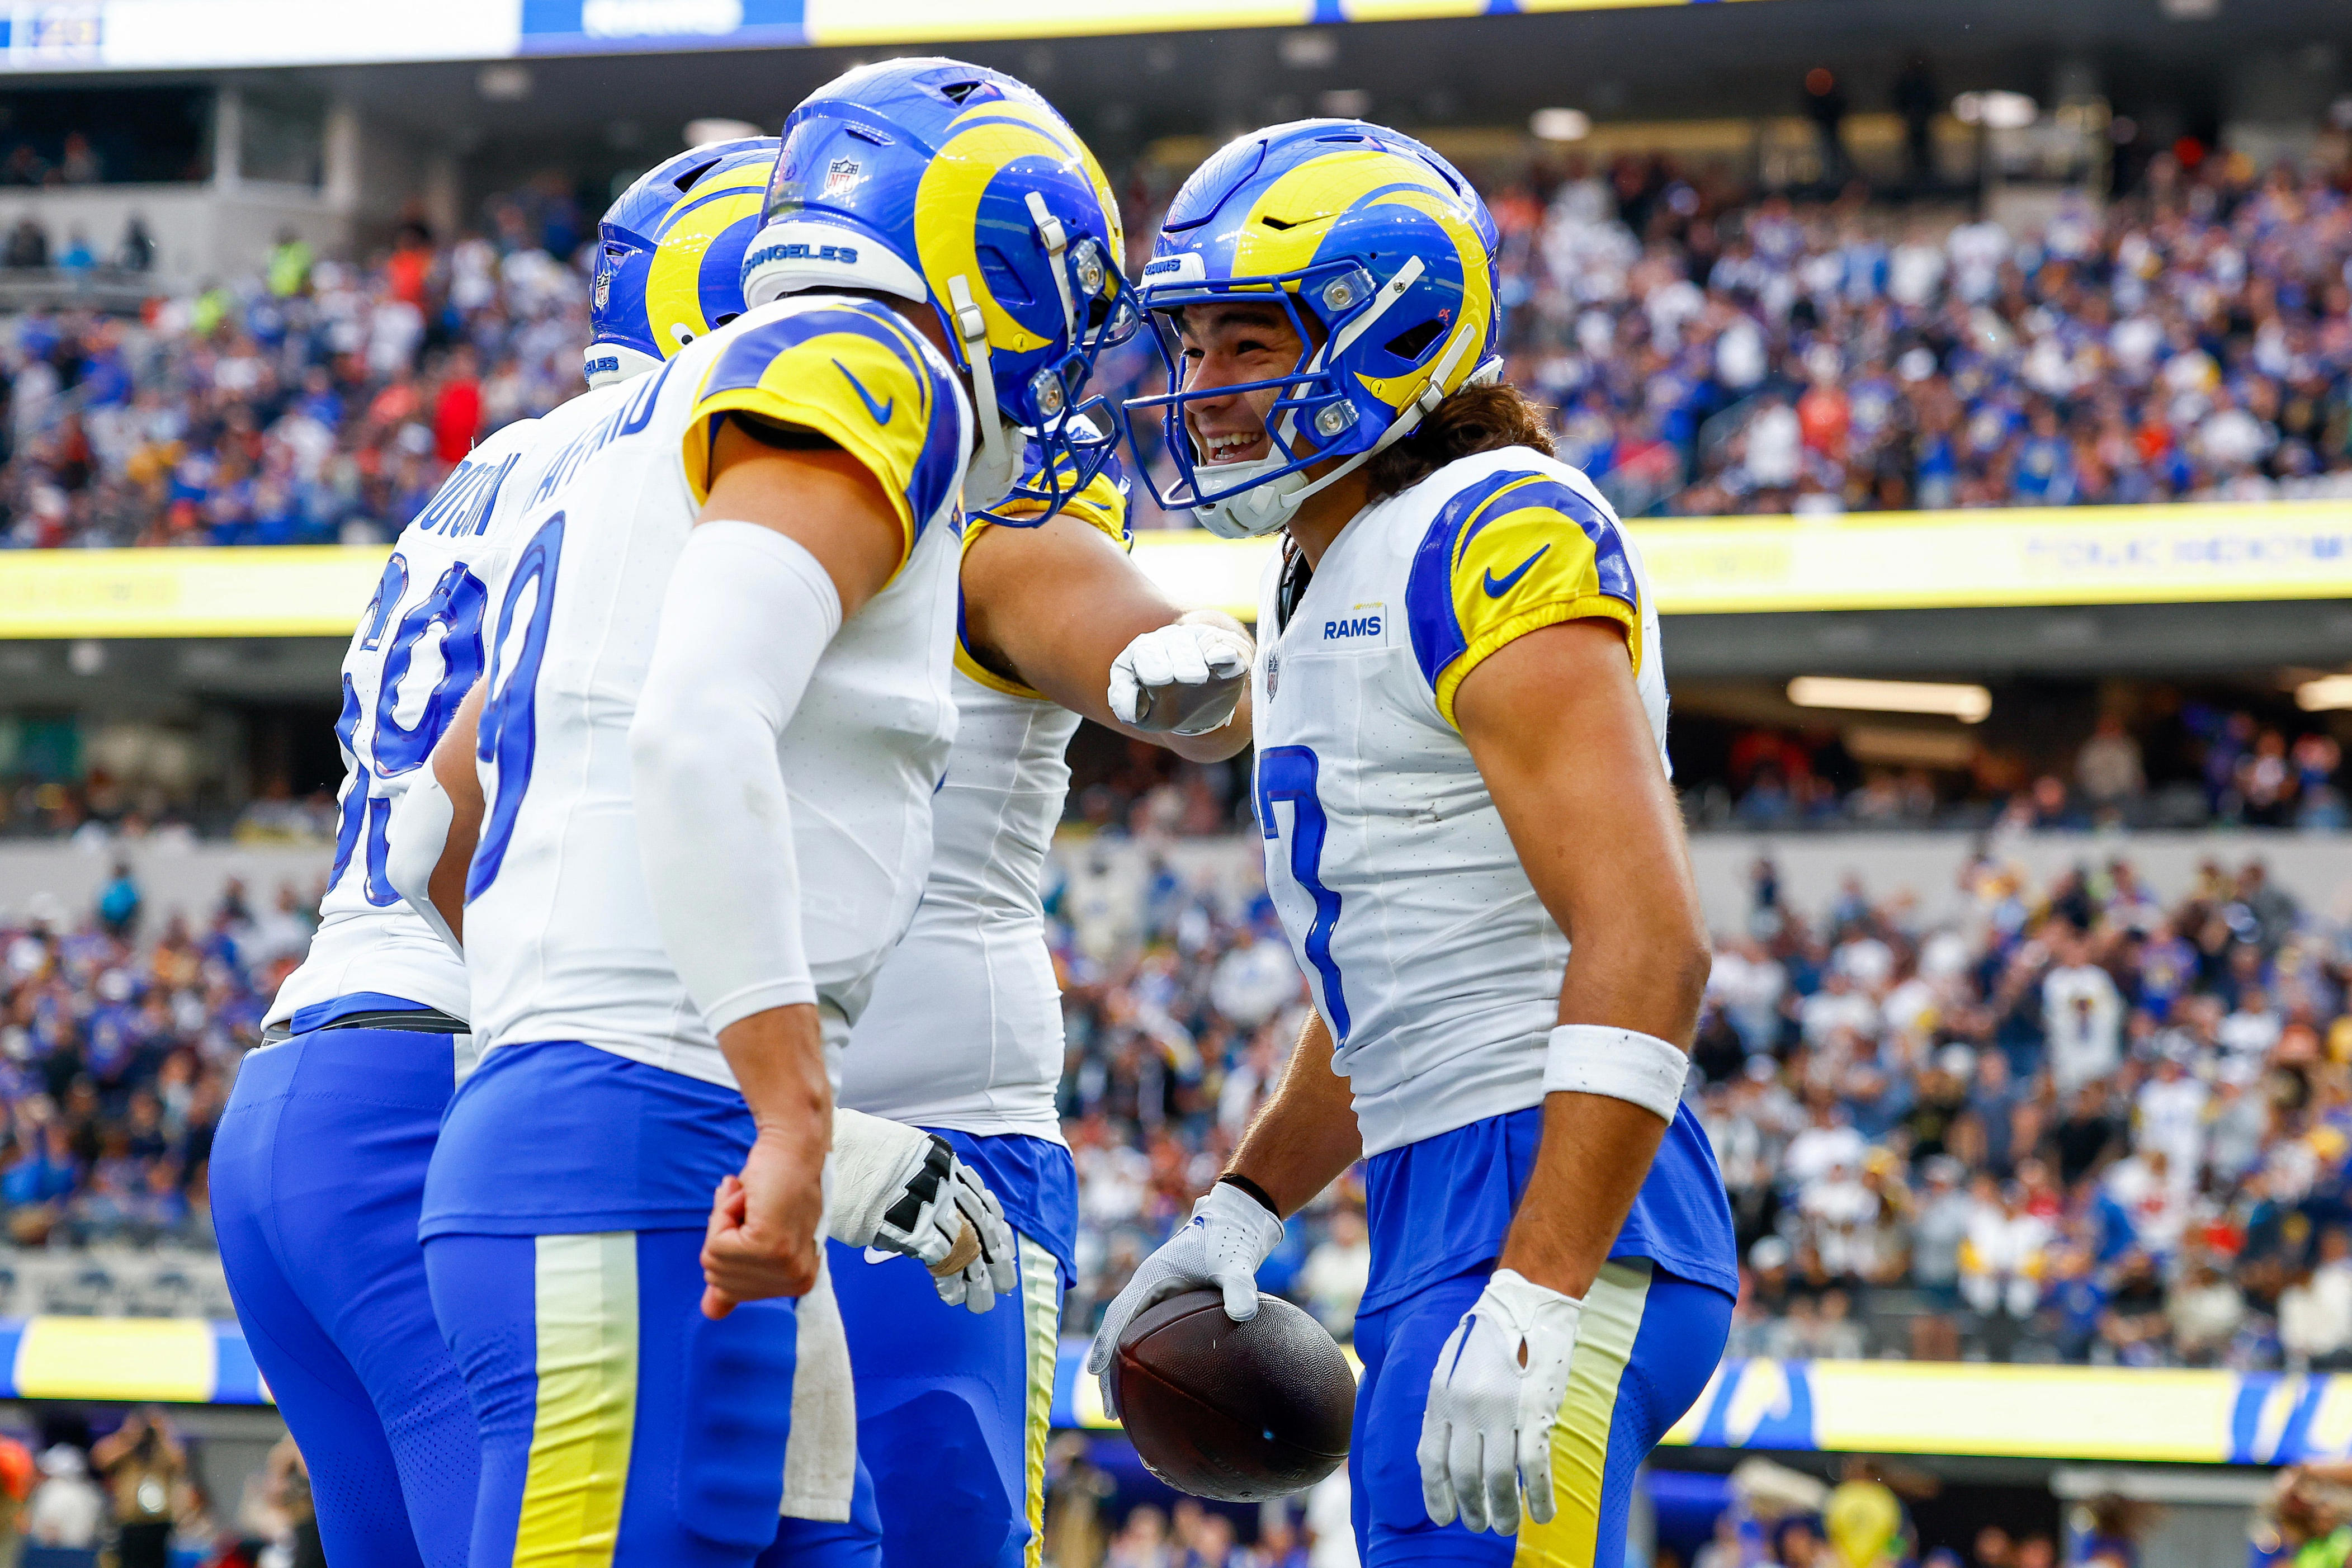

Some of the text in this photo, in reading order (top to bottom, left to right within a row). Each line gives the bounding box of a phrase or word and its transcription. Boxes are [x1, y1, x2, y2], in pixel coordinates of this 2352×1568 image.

[1145, 259, 1180, 275] RAMS
[597, 287, 607, 300] NFL
[1324, 616, 1381, 640] RAMS
[464, 510, 565, 910] 9
[1251, 744, 1351, 1051] 7
